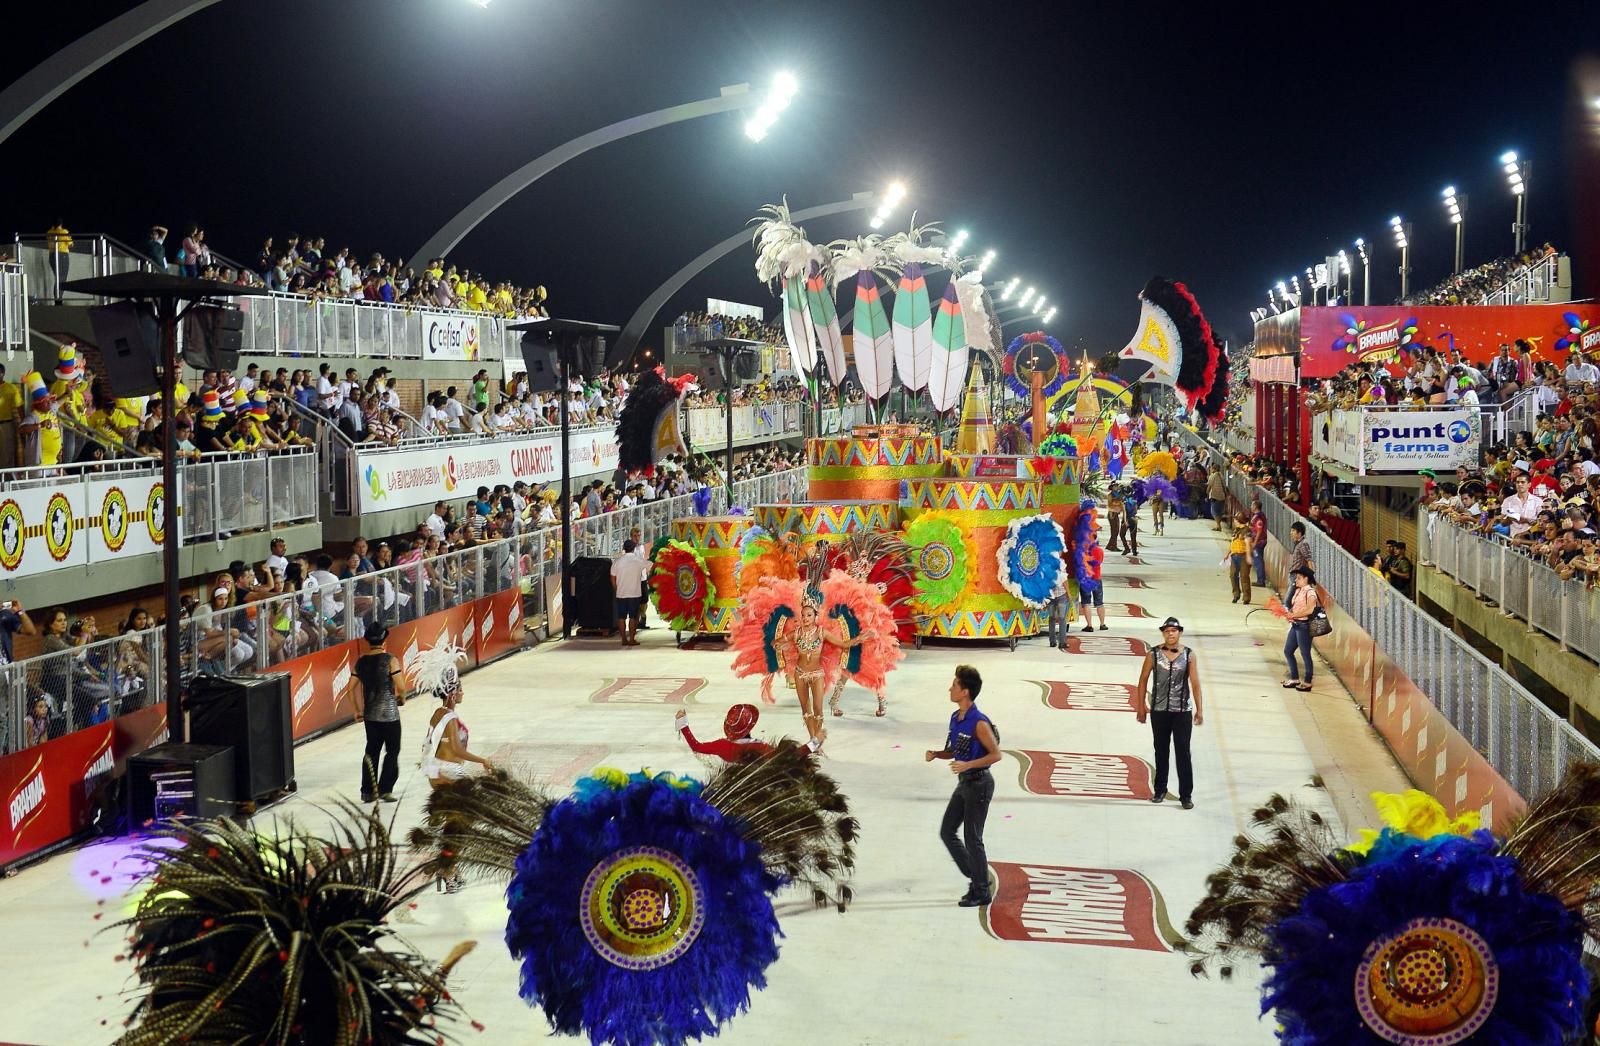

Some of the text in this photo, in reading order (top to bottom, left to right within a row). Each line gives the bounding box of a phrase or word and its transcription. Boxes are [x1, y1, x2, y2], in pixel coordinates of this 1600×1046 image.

[1359, 327, 1400, 351] BRAHMA
[510, 446, 554, 477] CAMAROTE
[1384, 442, 1449, 453] farma
[1050, 753, 1135, 797] BRAHMA
[10, 771, 46, 831] BRAHMA
[1020, 867, 1135, 942] BRAHMA
